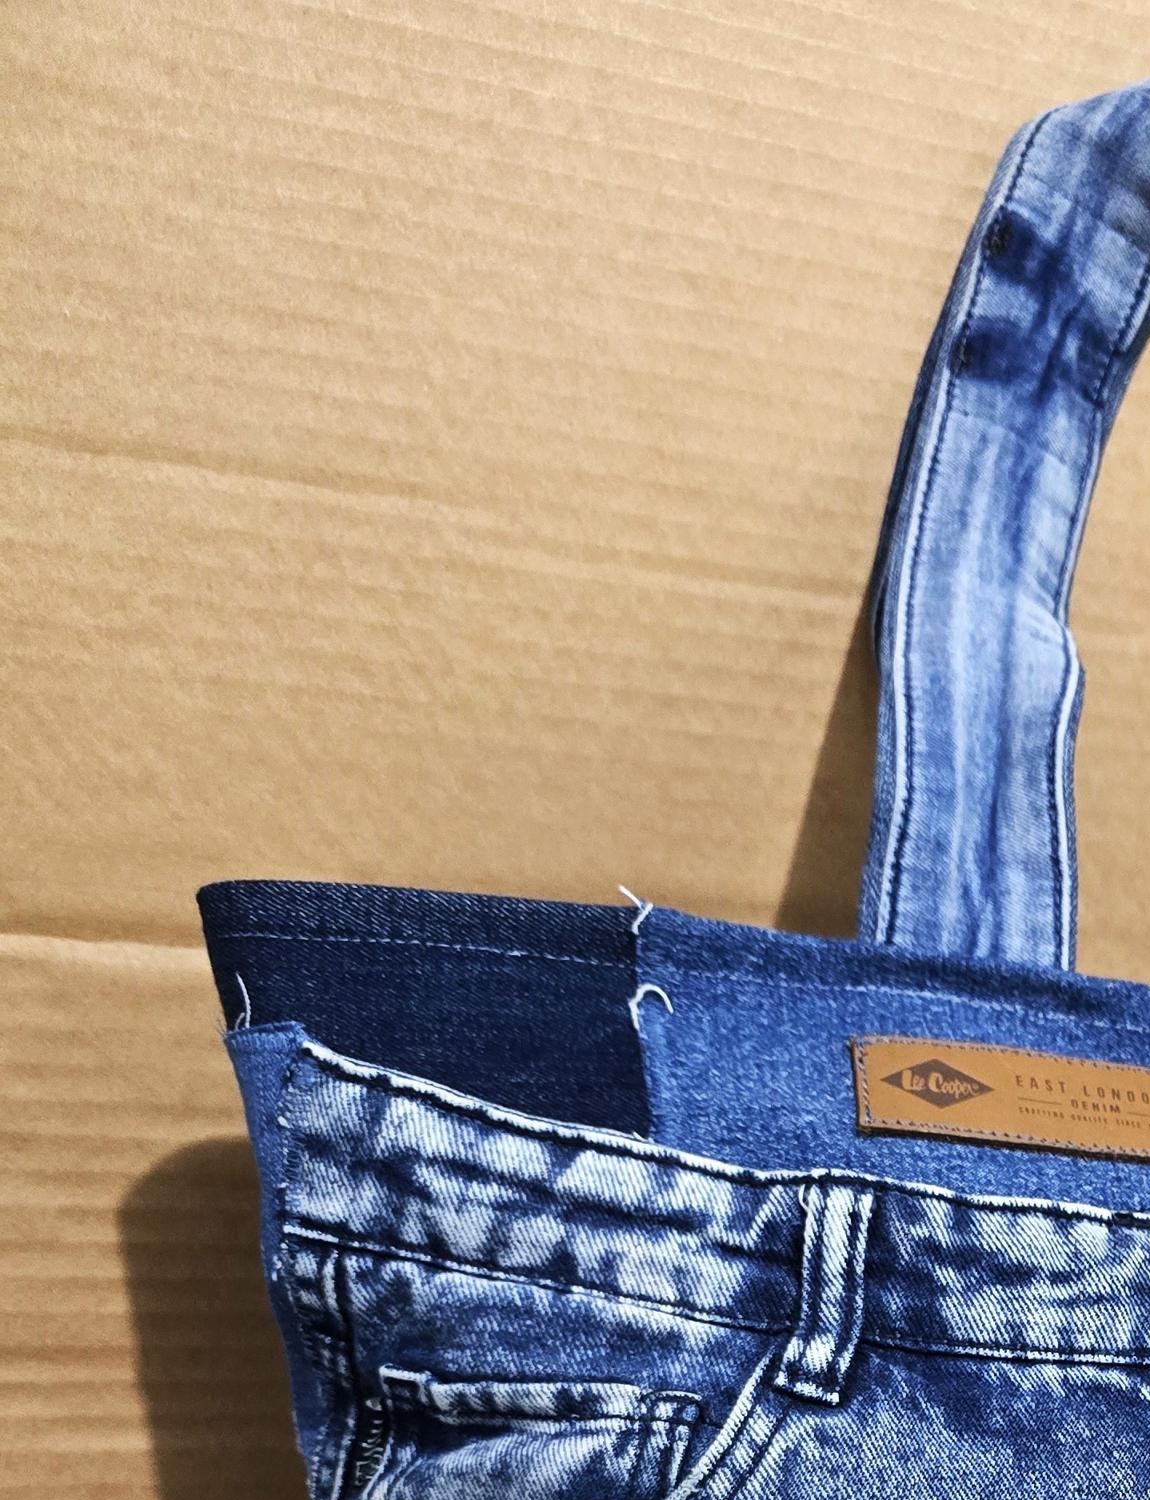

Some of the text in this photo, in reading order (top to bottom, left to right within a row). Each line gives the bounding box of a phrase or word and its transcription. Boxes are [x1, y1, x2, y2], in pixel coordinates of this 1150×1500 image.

[901, 1069, 979, 1098] Lee Cooper
[1015, 1075, 1066, 1094] EAST
[1071, 1099, 1121, 1114] DENIM
